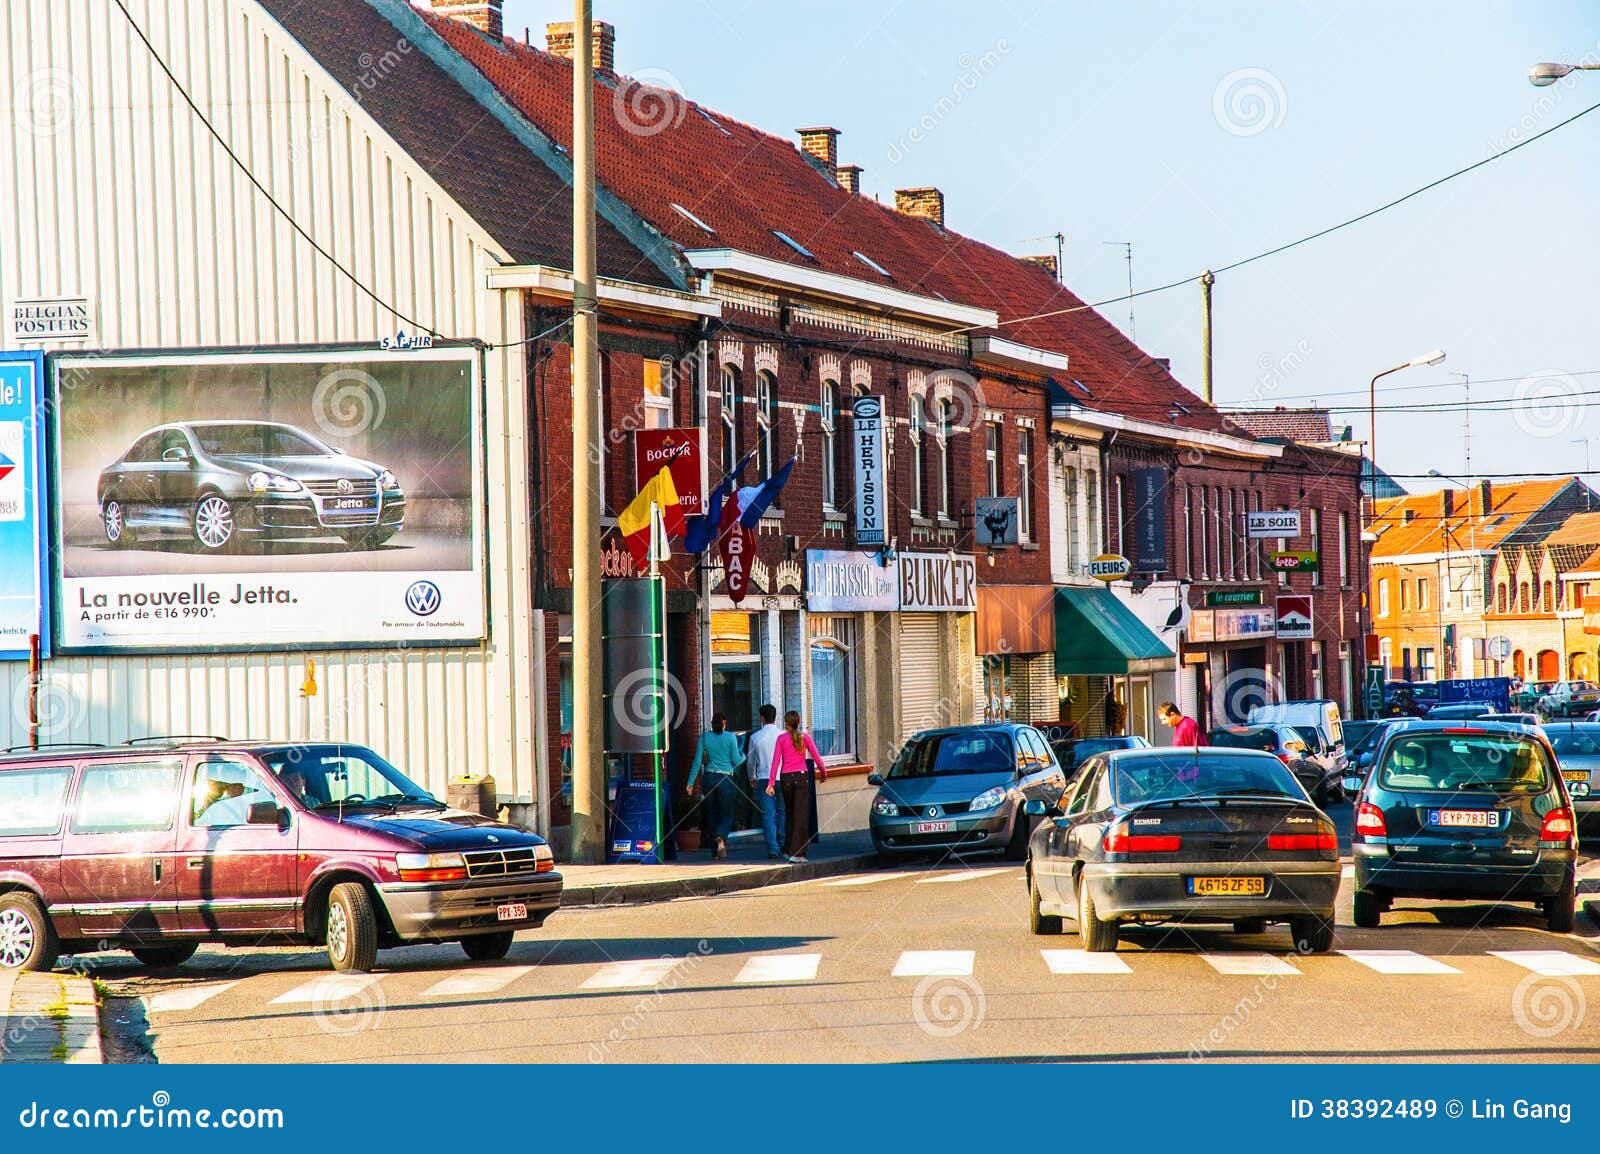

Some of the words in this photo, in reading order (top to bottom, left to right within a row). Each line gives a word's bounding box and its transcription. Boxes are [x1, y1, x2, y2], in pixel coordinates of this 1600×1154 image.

[15, 305, 87, 319] BELGIAN
[15, 319, 88, 333] POSTERS
[0, 377, 22, 406] le!
[858, 420, 876, 431] LE
[860, 435, 877, 529] HERISSON
[334, 498, 364, 509] Jetta
[678, 491, 698, 506] erie
[1250, 518, 1265, 528] LE
[1268, 517, 1298, 527] SOIR
[600, 537, 633, 578] ockor
[728, 526, 744, 591] ABAC
[1091, 561, 1126, 575] FLEURS
[902, 556, 976, 607] BUNKER
[79, 587, 107, 608] La
[118, 583, 221, 607] nouvelle
[230, 583, 299, 605] Jetta.
[80, 610, 91, 621] A
[95, 609, 130, 624] partir
[134, 607, 150, 620] de
[154, 607, 178, 619] €16
[1488, 812, 1497, 825] B
[1198, 878, 1229, 892] 4675
[1231, 878, 1245, 891] ZF
[1246, 877, 1262, 891] 59
